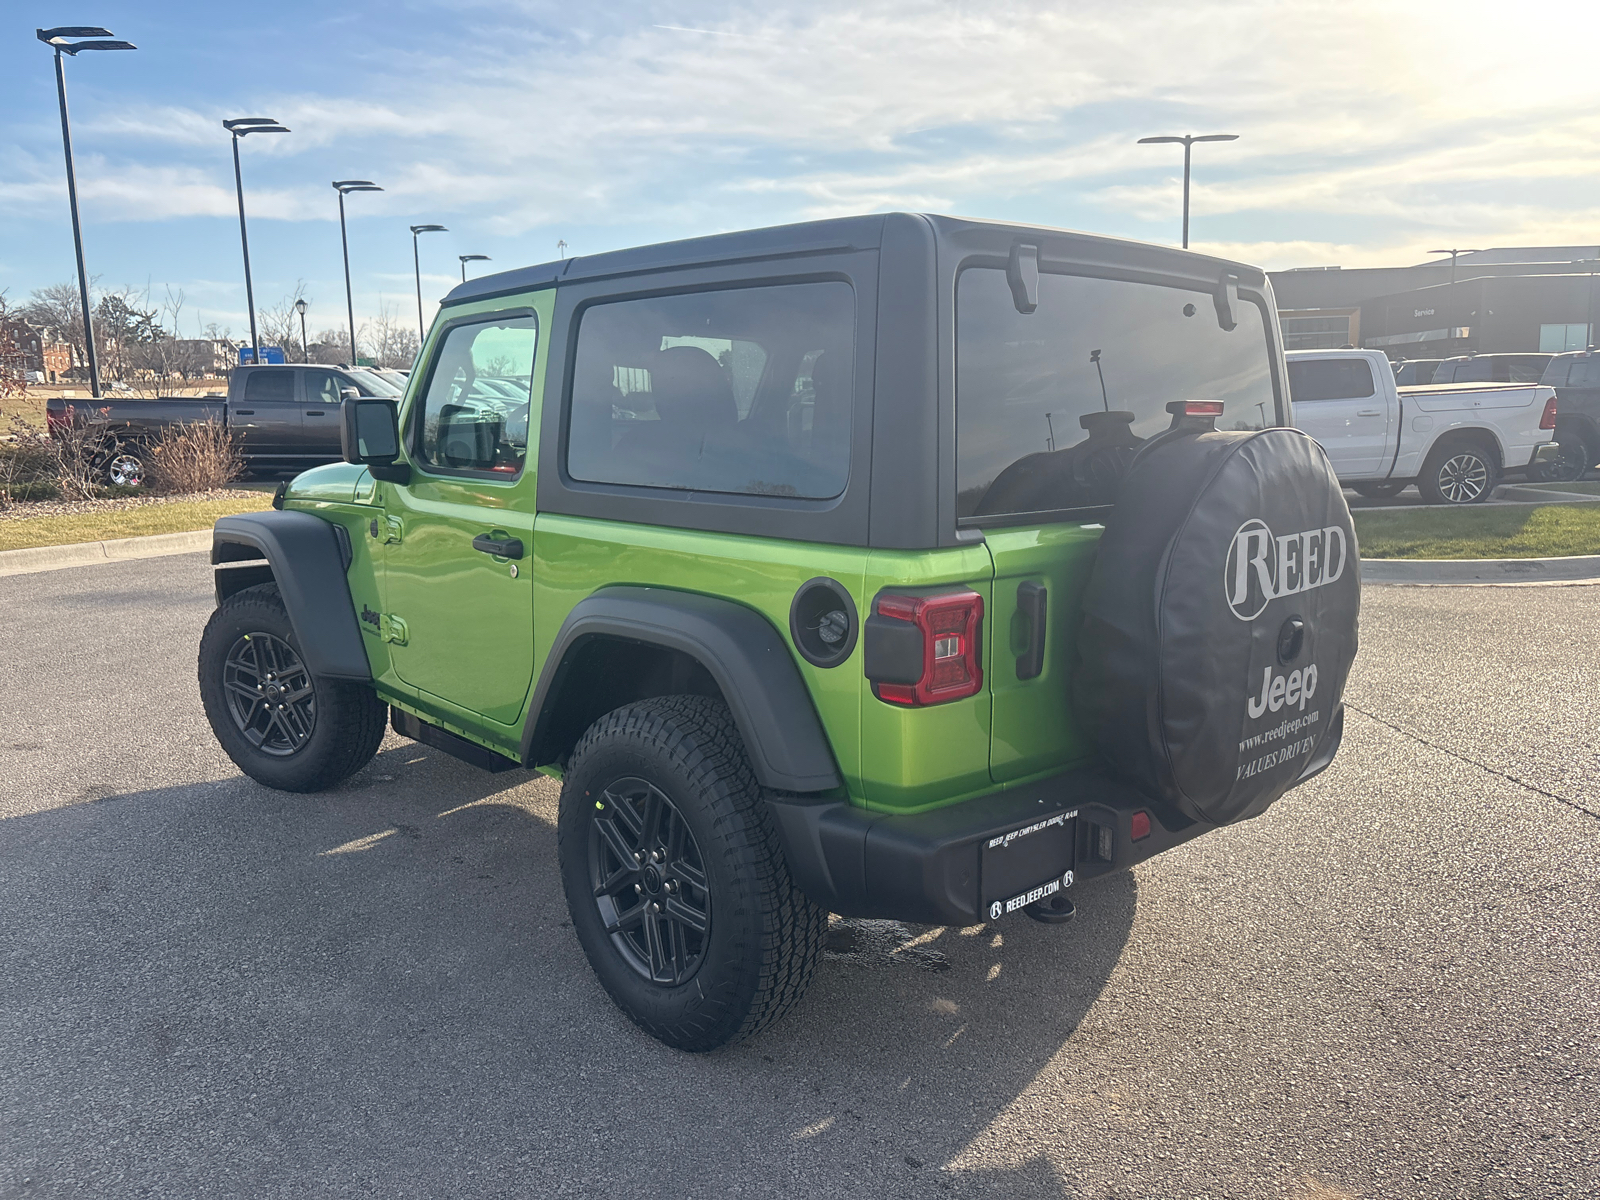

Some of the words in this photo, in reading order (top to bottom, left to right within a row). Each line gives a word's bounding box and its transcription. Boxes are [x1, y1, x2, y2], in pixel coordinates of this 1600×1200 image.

[1414, 307, 1435, 318] Service
[1230, 524, 1347, 606] REED
[1248, 663, 1318, 719] Jeep
[1239, 711, 1319, 752] www.reedjeep.com
[1236, 751, 1279, 781] VALUES
[1278, 734, 1317, 764] DRIVEN
[989, 836, 1004, 849] REED
[1005, 831, 1018, 841] JEEP
[1019, 821, 1047, 837] CHRYSLER
[1047, 814, 1064, 827] DODGE
[1064, 809, 1078, 820] RAM
[1006, 880, 1060, 913] REEDJEEP.COM
